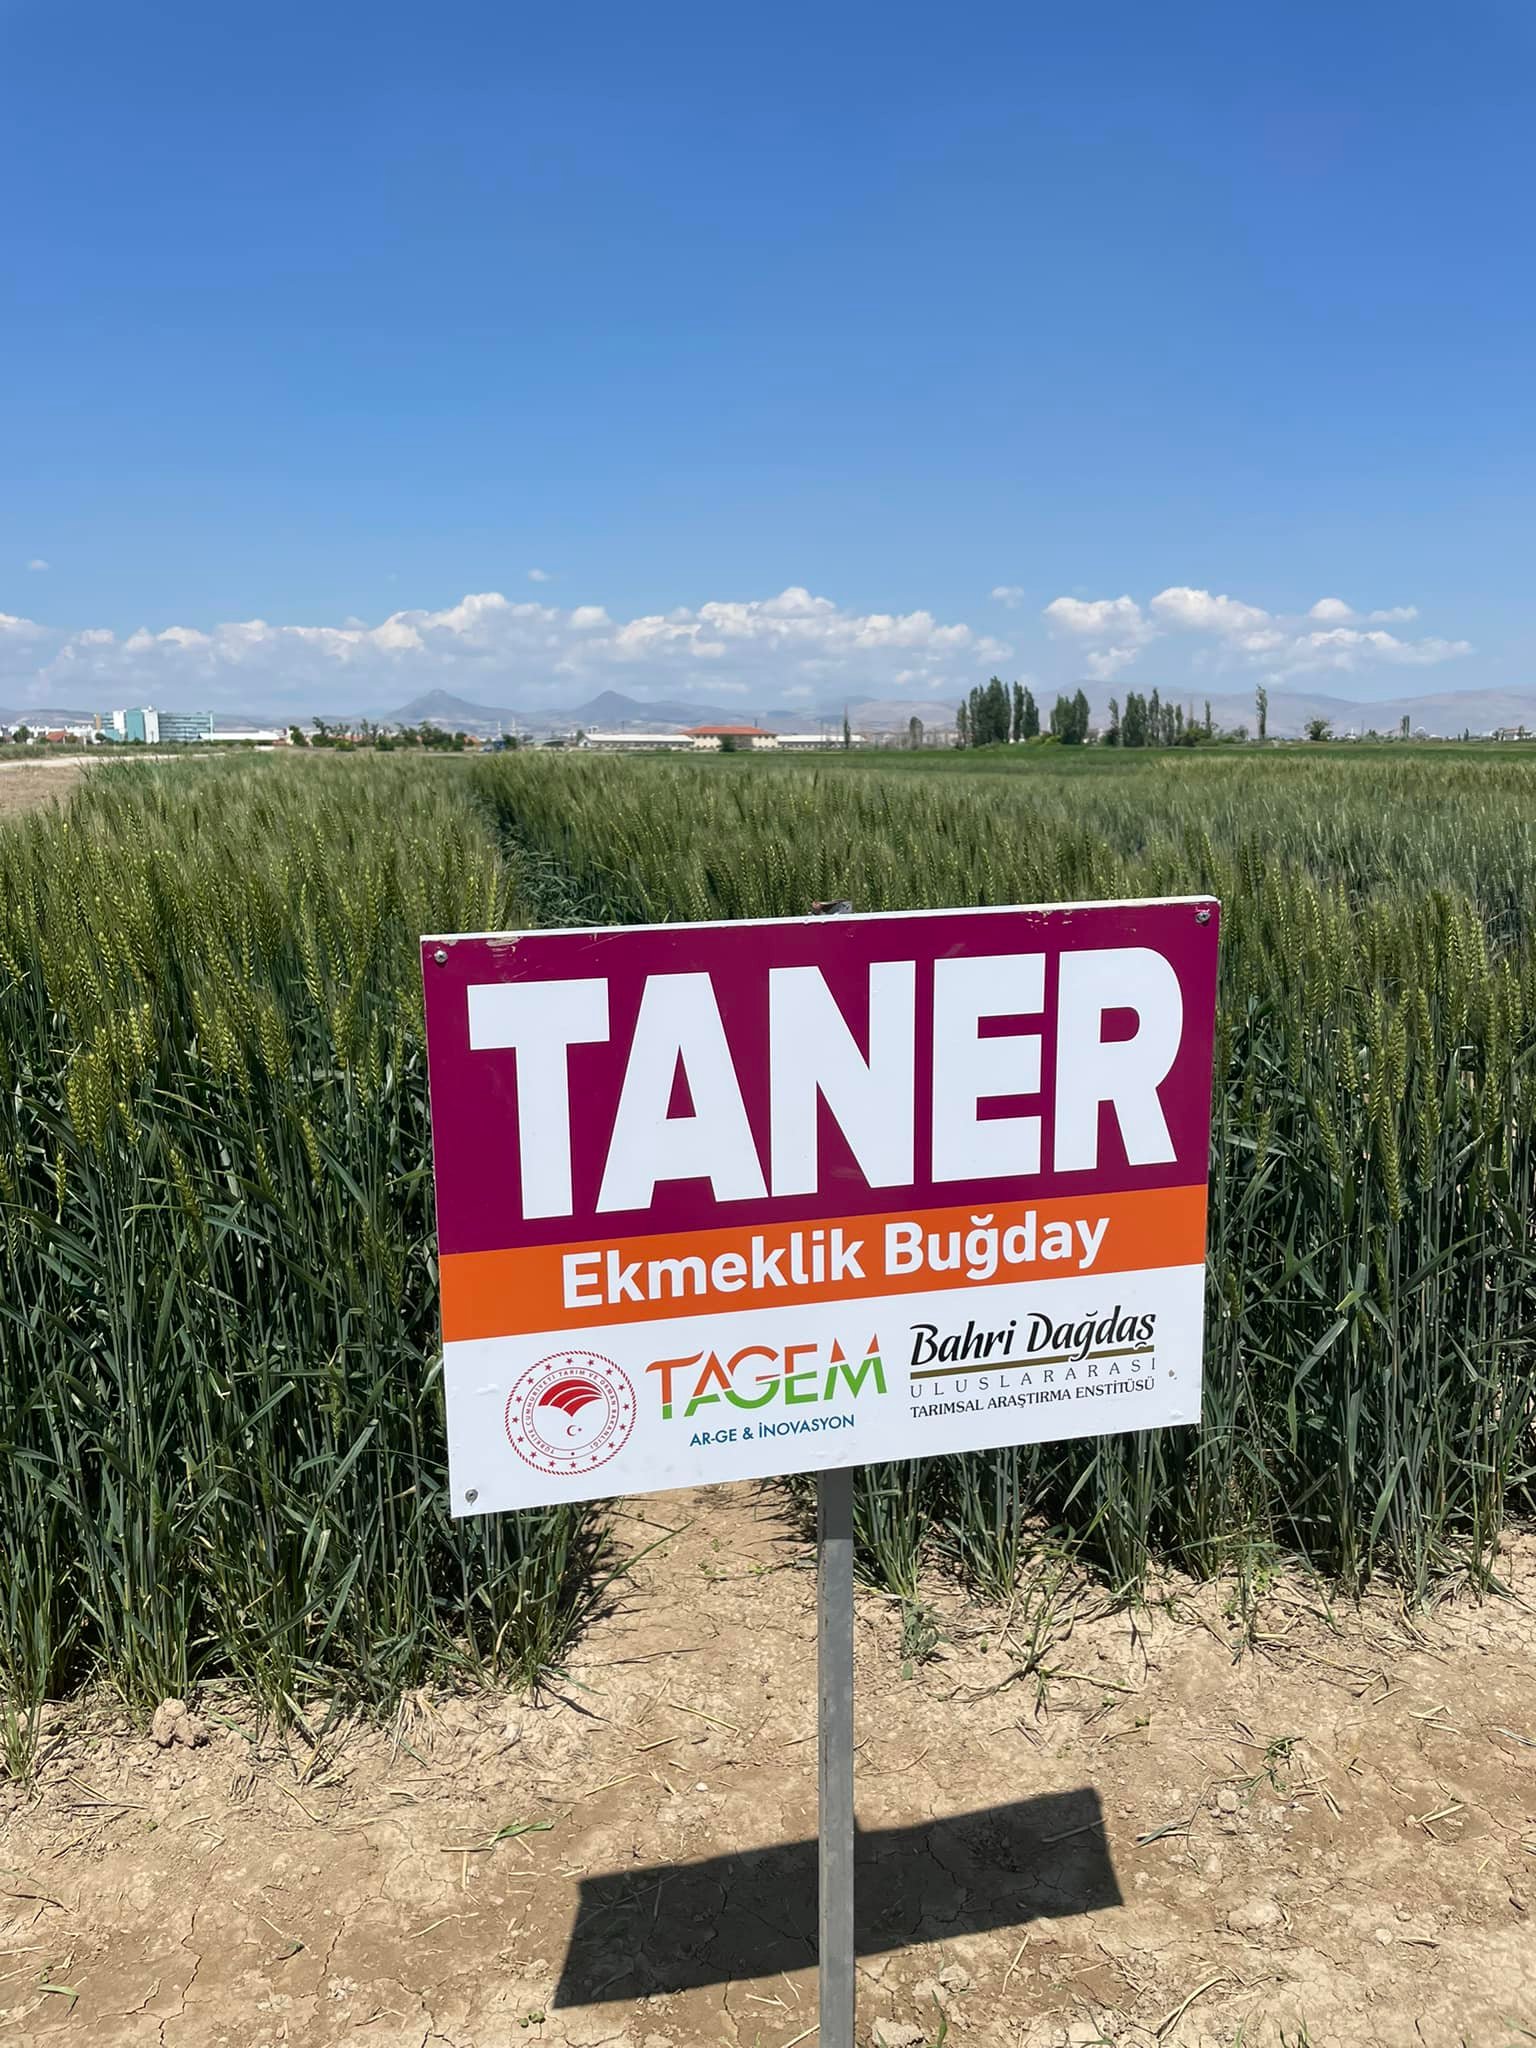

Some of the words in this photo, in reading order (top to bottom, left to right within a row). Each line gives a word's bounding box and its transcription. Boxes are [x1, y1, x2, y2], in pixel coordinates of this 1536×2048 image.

[467, 947, 1183, 1219] TANER
[563, 1228, 865, 1308] Ekmeklik
[885, 1211, 1109, 1278] Buğday
[910, 1320, 1016, 1365] Bahri
[1026, 1305, 1156, 1362] Dağdaş
[559, 1369, 586, 1377] TARIM
[588, 1373, 598, 1381] VE
[599, 1380, 617, 1408] ORMAN
[645, 1333, 888, 1420] TAGEM
[909, 1357, 1156, 1398] ULUSLARARASI
[910, 1398, 984, 1418] TARIMSAL
[988, 1389, 1071, 1409] ARAŞTIRMA
[1075, 1377, 1155, 1398] ENSTİTÜSÜ
[690, 1429, 736, 1446] AR-GE
[743, 1427, 753, 1440] &
[759, 1415, 854, 1438] İNOVASYON
